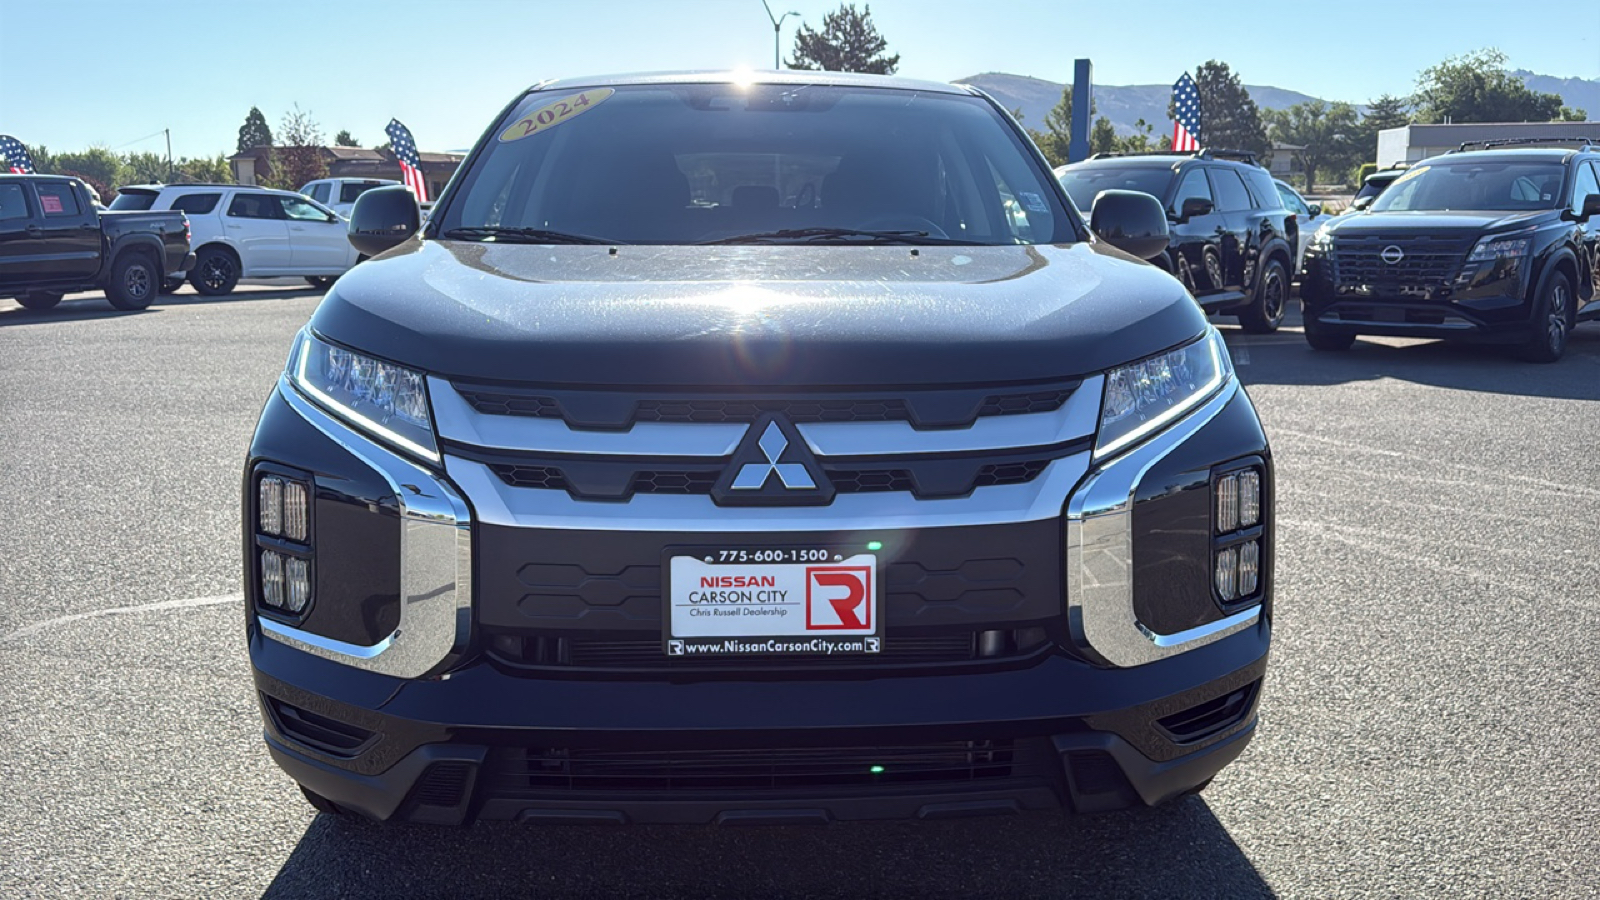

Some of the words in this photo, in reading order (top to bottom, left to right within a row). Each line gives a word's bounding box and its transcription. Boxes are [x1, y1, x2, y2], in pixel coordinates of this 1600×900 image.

[519, 93, 590, 136] 2024
[719, 550, 829, 562] 775-600-1500
[700, 576, 775, 588] NISSAN
[688, 591, 752, 604] CARSON
[756, 590, 788, 603] CITY
[689, 608, 711, 617] Chris
[713, 608, 741, 617] Russell
[743, 607, 788, 617] Dealership
[686, 639, 862, 655] www.NissanCarsonCity.com
